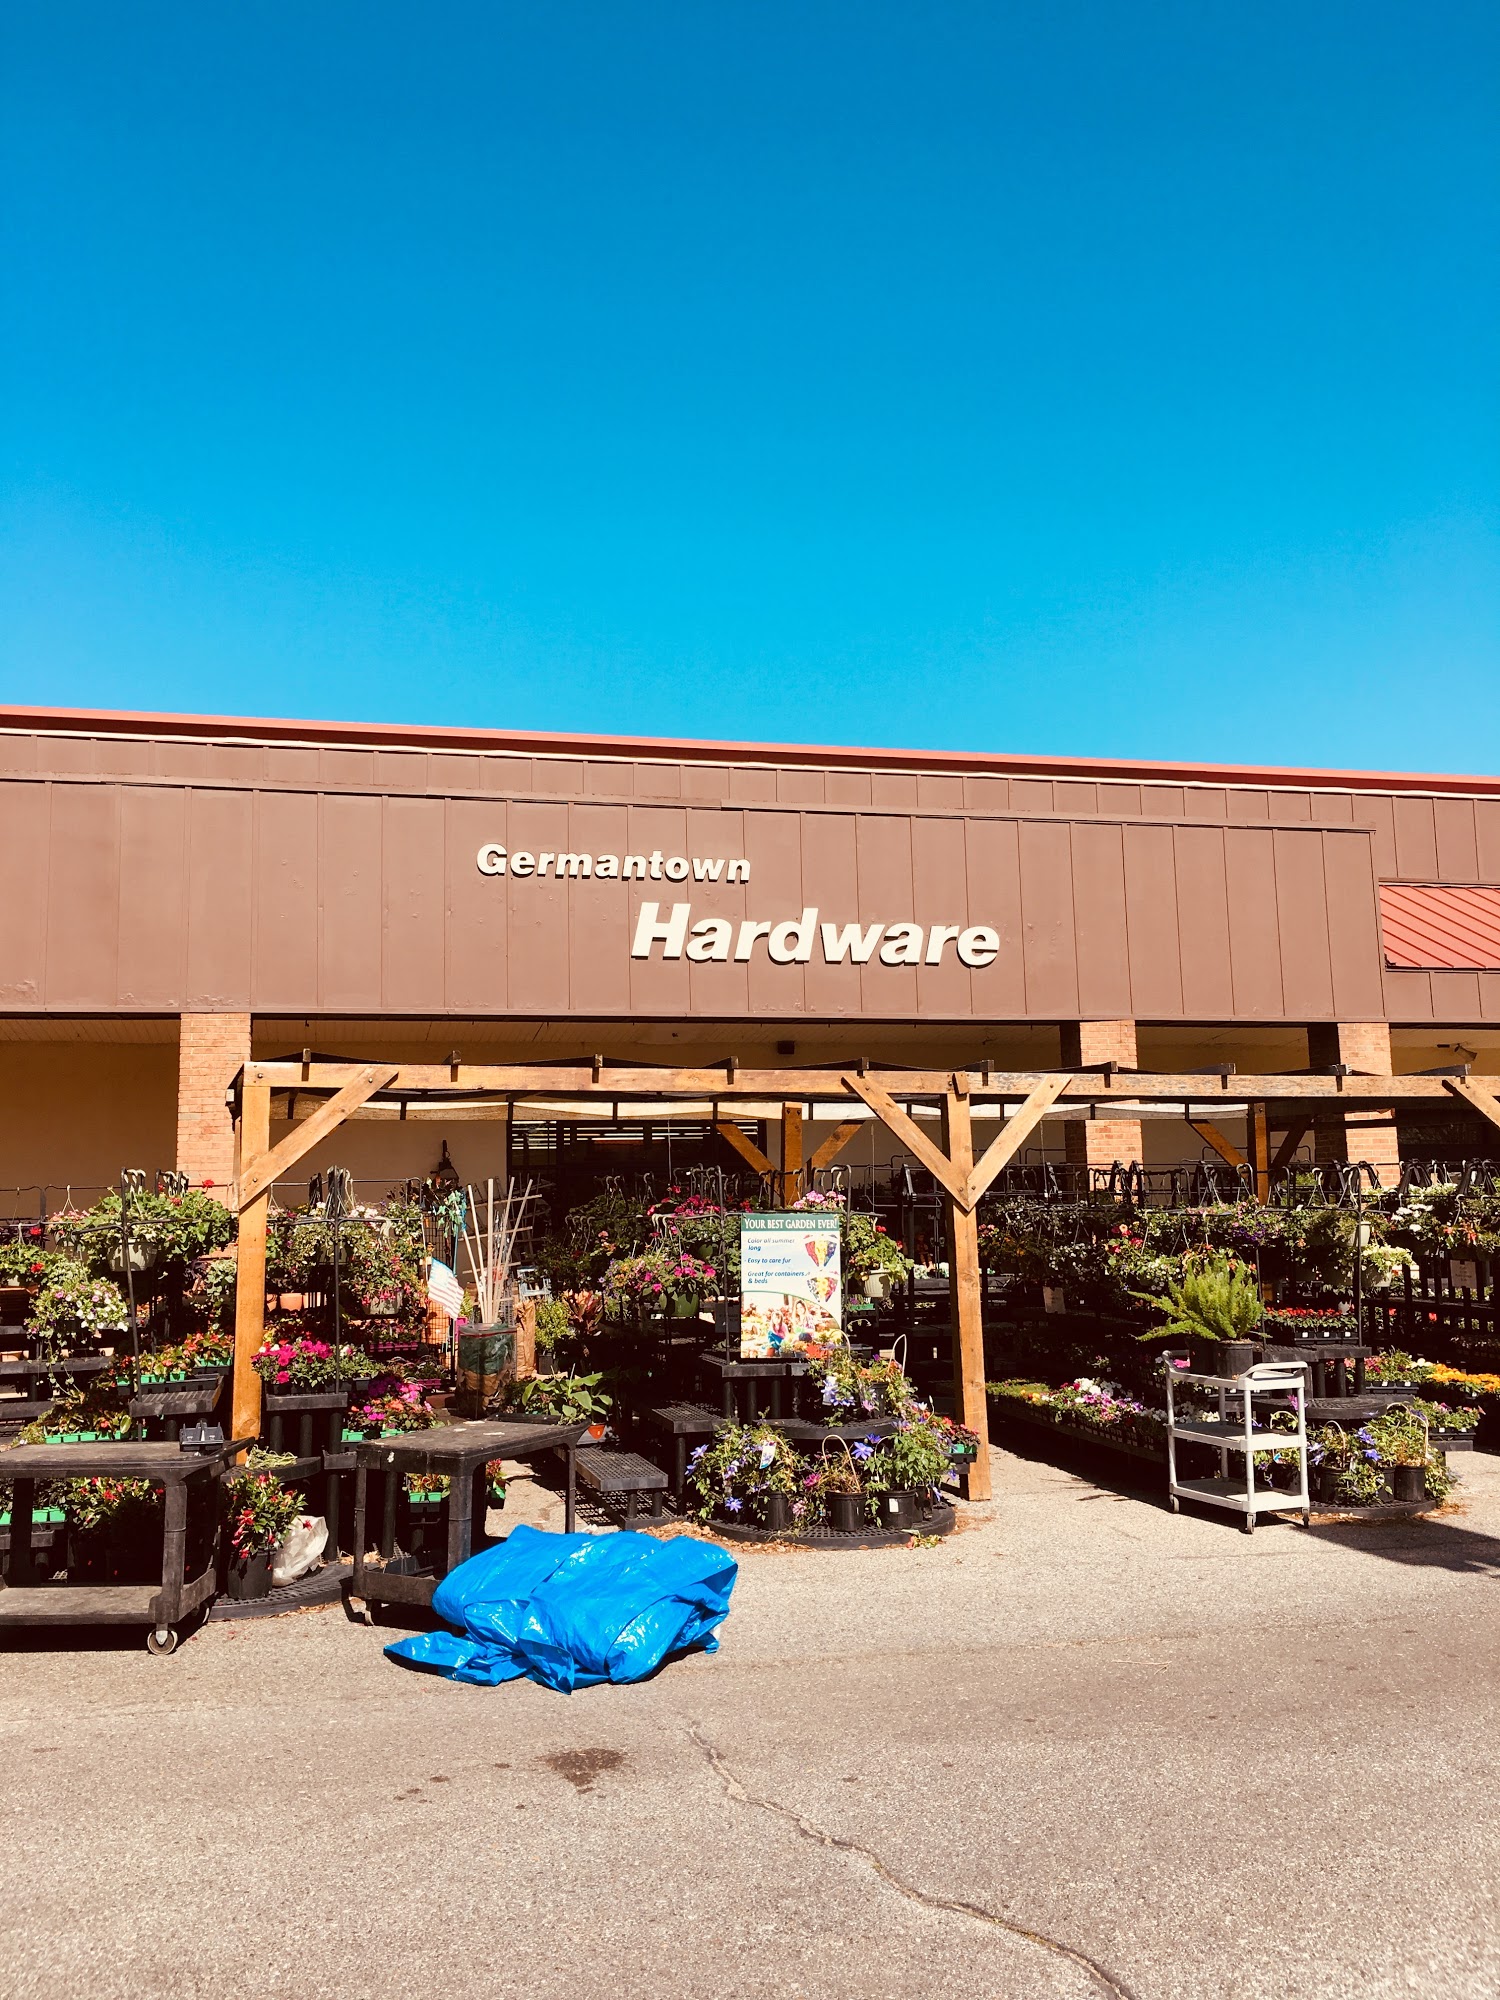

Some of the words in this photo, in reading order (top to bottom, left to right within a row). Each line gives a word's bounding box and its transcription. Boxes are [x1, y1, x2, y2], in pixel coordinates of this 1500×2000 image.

[475, 843, 751, 884] Germantown
[630, 901, 1000, 968] Hardware
[744, 1218, 766, 1229] YOUR
[767, 1219, 784, 1229] BEST
[785, 1219, 816, 1229] GARDEN
[818, 1219, 838, 1229] EVER!
